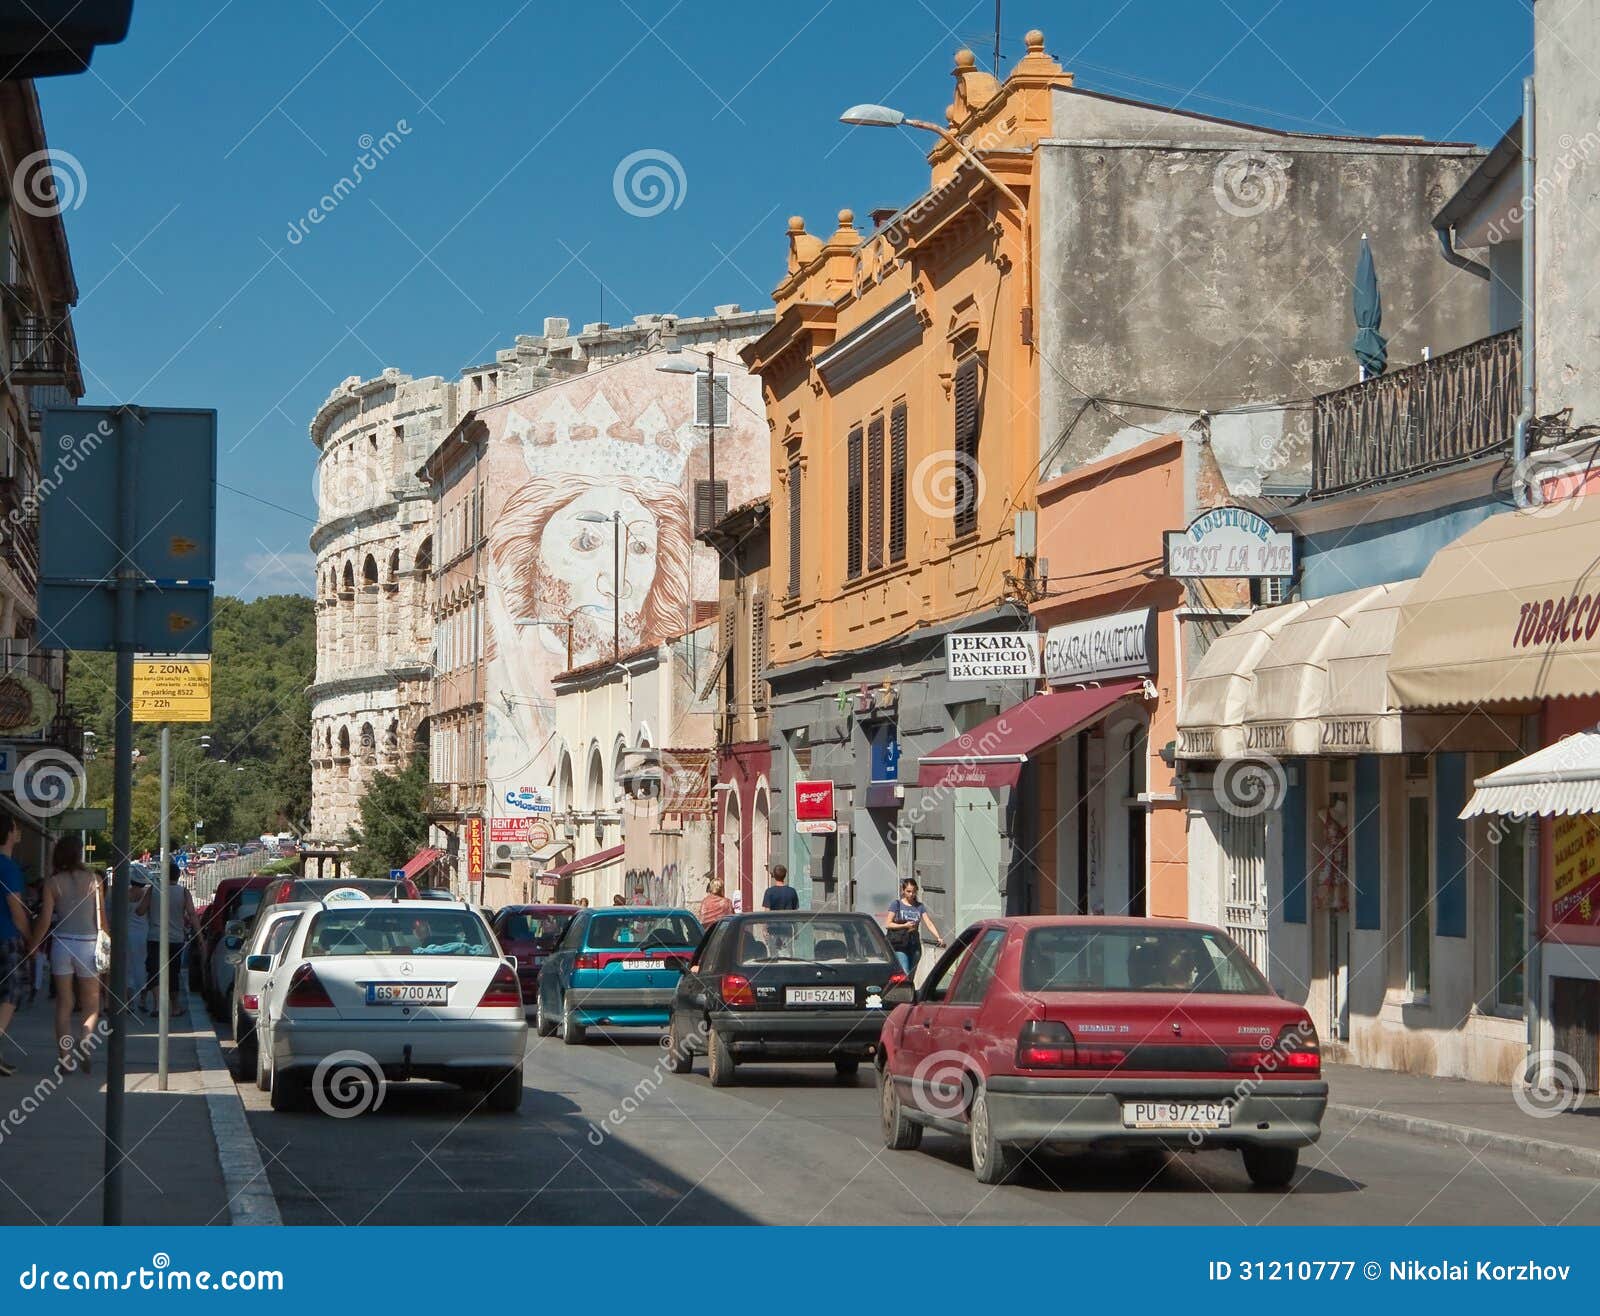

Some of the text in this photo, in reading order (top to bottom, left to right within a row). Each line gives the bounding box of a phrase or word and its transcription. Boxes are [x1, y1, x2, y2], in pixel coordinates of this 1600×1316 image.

[1191, 509, 1270, 543] BOUTIQUE
[1170, 542, 1292, 573] C'EST LA VIE
[1512, 592, 1600, 649] TOBACCO
[952, 636, 1025, 650] PEKARA
[1046, 633, 1089, 673] PEKARA
[1094, 623, 1146, 665] PANIFICIO
[952, 652, 1027, 663] PANIFICIO
[148, 665, 190, 674] 2. ZONA
[953, 664, 1027, 677] BÄCKEREI
[142, 689, 176, 697] m-parking
[154, 700, 170, 708] 22h
[519, 786, 538, 794] GRILL
[492, 819, 511, 829] RENT
[512, 820, 518, 829] A
[472, 819, 481, 873] PEKARA
[377, 987, 442, 999] GS 700 AX
[794, 991, 807, 1002] PU
[1136, 1104, 1157, 1121] PU
